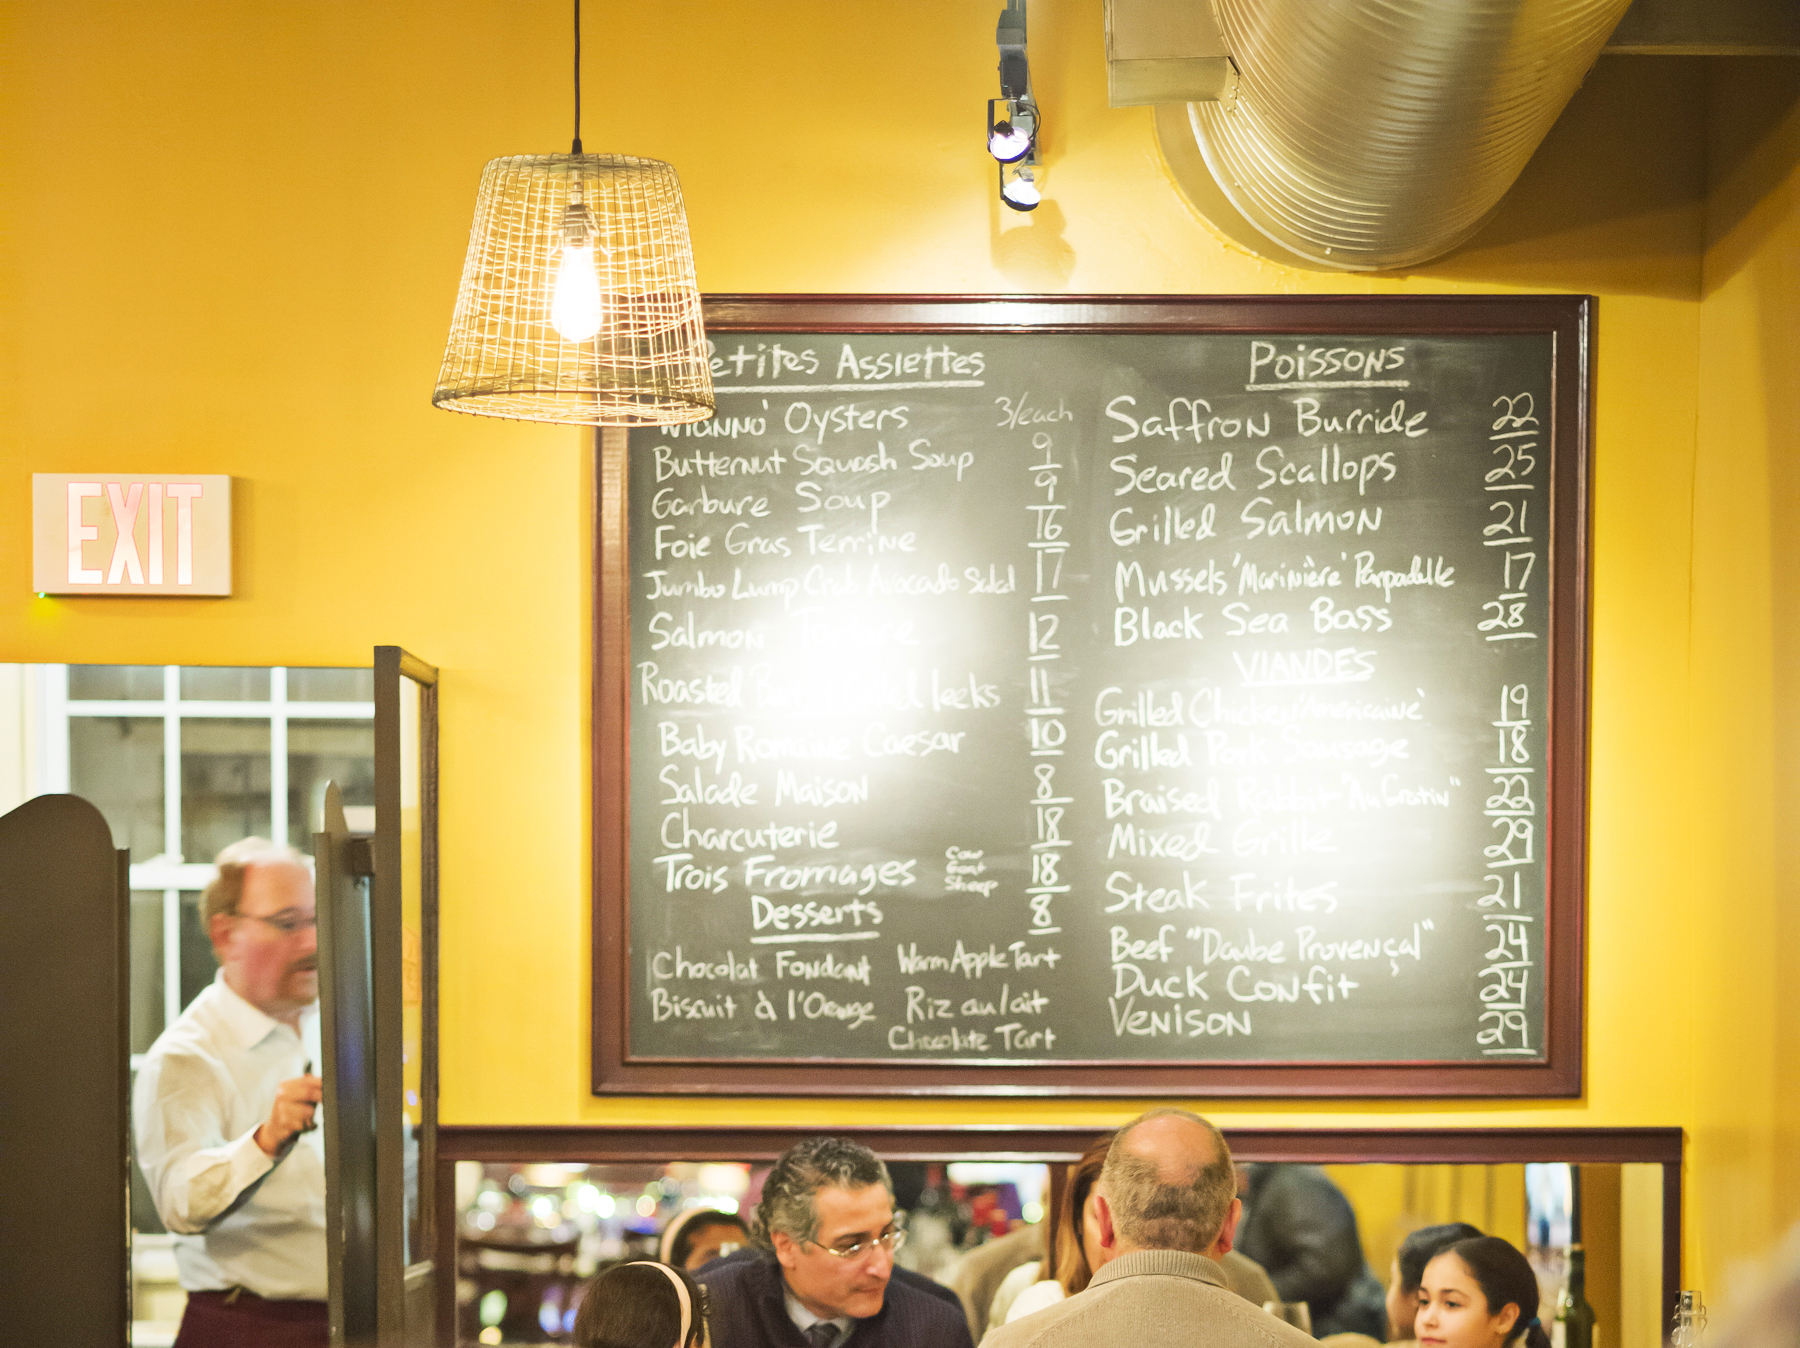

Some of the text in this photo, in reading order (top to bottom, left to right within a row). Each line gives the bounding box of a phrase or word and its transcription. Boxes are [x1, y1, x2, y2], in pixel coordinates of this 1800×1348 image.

[836, 343, 986, 381] Assiettes
[784, 401, 909, 445] Oysters
[995, 391, 1073, 430] 3/each
[1105, 395, 1429, 444] Saffron Burride
[1492, 392, 1540, 431] 22
[653, 439, 975, 483] Butternut Squash Soup
[1032, 431, 1053, 465] 9
[1485, 443, 1537, 483] 25
[1034, 470, 1058, 503] 9
[1109, 445, 1398, 497] Seared Scallops
[652, 481, 891, 534] Garbure Soup
[1036, 508, 1063, 541] 16
[1109, 497, 1383, 548] Grilled Salmon
[1483, 500, 1527, 537] 21
[67, 481, 203, 586] EXIT
[654, 522, 918, 561] Foie Gras Terrine
[642, 569, 726, 600] Jumbo
[731, 568, 800, 610] Lump
[1036, 548, 1067, 594] 17
[1115, 559, 1229, 603] Mussels
[1504, 551, 1536, 591] 17
[648, 609, 765, 651] Salmon
[1028, 611, 1061, 654] 12
[1114, 596, 1393, 647] Black Sea Bass
[1477, 601, 1527, 631] 28
[637, 661, 744, 708] Roasted
[1232, 648, 1378, 681] VIANDES
[1029, 666, 1050, 707] 11
[1501, 684, 1529, 722] 19
[1095, 687, 1184, 728] Grilled
[657, 721, 728, 775] Baby
[862, 721, 967, 758] Caesar
[1031, 717, 1067, 749] 10
[1095, 730, 1192, 771] Grilled
[1280, 724, 1410, 768] Sausage
[1500, 725, 1530, 764] 18
[658, 763, 869, 808] Salade Maison
[1033, 763, 1056, 800] 8
[1102, 777, 1222, 821] Braised
[1486, 774, 1535, 812] 22
[659, 806, 840, 851] Charcuterie
[1037, 806, 1065, 842] 18
[1107, 815, 1339, 862] Mixed Grille
[1483, 816, 1534, 860] 29
[653, 853, 918, 895] Trois Fromages
[1032, 853, 1061, 886] 18
[1030, 893, 1052, 927] 8
[1104, 871, 1339, 914] Steak Frites
[1477, 871, 1521, 910] 21
[750, 894, 884, 930] Desserts
[897, 939, 1062, 979] Warm Apple Tart
[1109, 924, 1176, 962] Beef
[1485, 922, 1528, 961] 24
[652, 945, 759, 982] Chocolat
[905, 983, 1050, 1024] Riz au lait
[1112, 963, 1361, 1005] Duck Confit
[1478, 967, 1528, 1007] 24
[651, 987, 738, 1023] Biscuit
[1107, 995, 1252, 1037] Venison
[888, 1022, 1057, 1051] Chocolate Tart
[1476, 1011, 1528, 1048] 29
